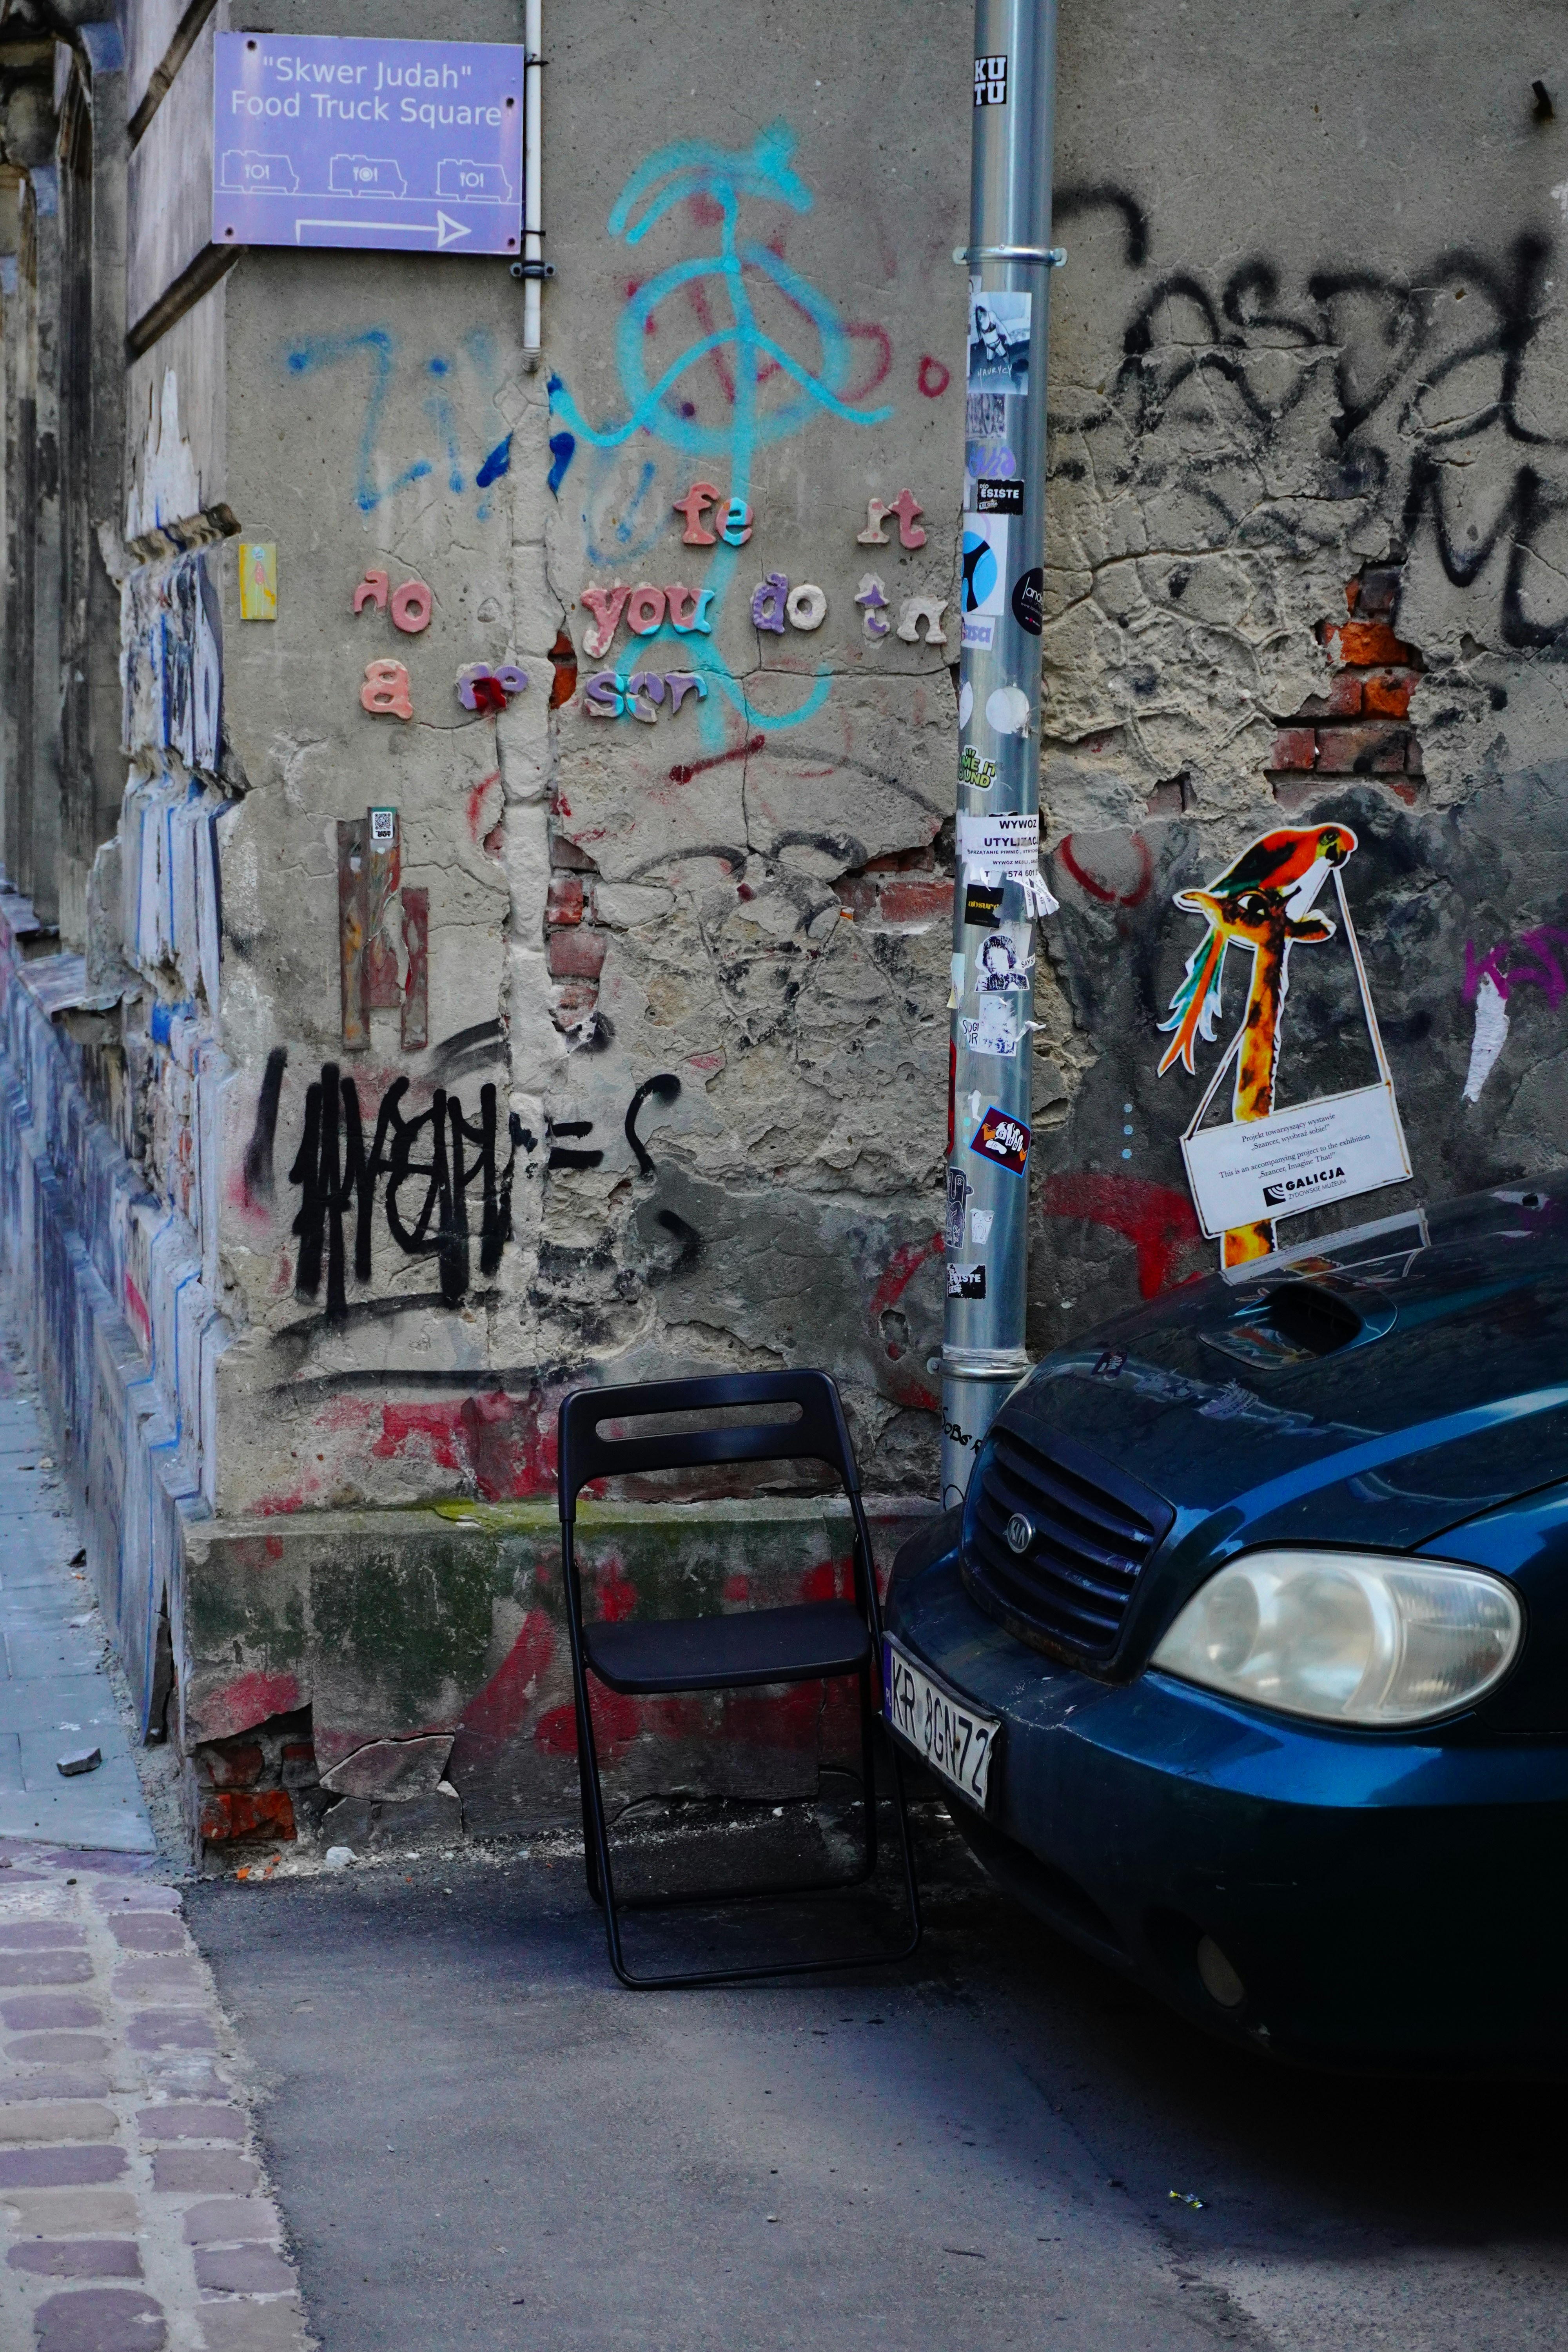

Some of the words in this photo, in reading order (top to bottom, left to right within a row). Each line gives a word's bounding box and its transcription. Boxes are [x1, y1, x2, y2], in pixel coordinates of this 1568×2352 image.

[263, 56, 367, 85] "Skwer
[374, 62, 471, 91] Judah"
[975, 57, 1006, 82] KU
[974, 81, 1005, 105] TU
[232, 91, 301, 117] Food
[310, 93, 389, 121] Truck
[400, 98, 502, 129] Square
[981, 488, 1019, 499] ESISTE
[581, 585, 715, 659] you
[751, 573, 827, 634] do
[361, 659, 413, 719] a
[1000, 818, 1036, 829] WYWÓZ
[1242, 1132, 1264, 1142] Projekt
[1265, 1122, 1306, 1136] towarzyszący
[1308, 1113, 1335, 1125] wystawie
[1281, 1130, 1308, 1142] wyobraź
[1251, 1154, 1295, 1170] accompanying
[1297, 1147, 1319, 1159] project
[1339, 1134, 1370, 1146] exhibition
[1288, 1160, 1313, 1170] Imagine
[1286, 1167, 1345, 1191] GALICJA
[1322, 1179, 1347, 1190] MUZEUM
[1010, 1520, 1025, 1547] KIA
[886, 1687, 891, 1708] PL
[893, 1656, 916, 1739] KR
[925, 1687, 989, 1798] 8GN72
